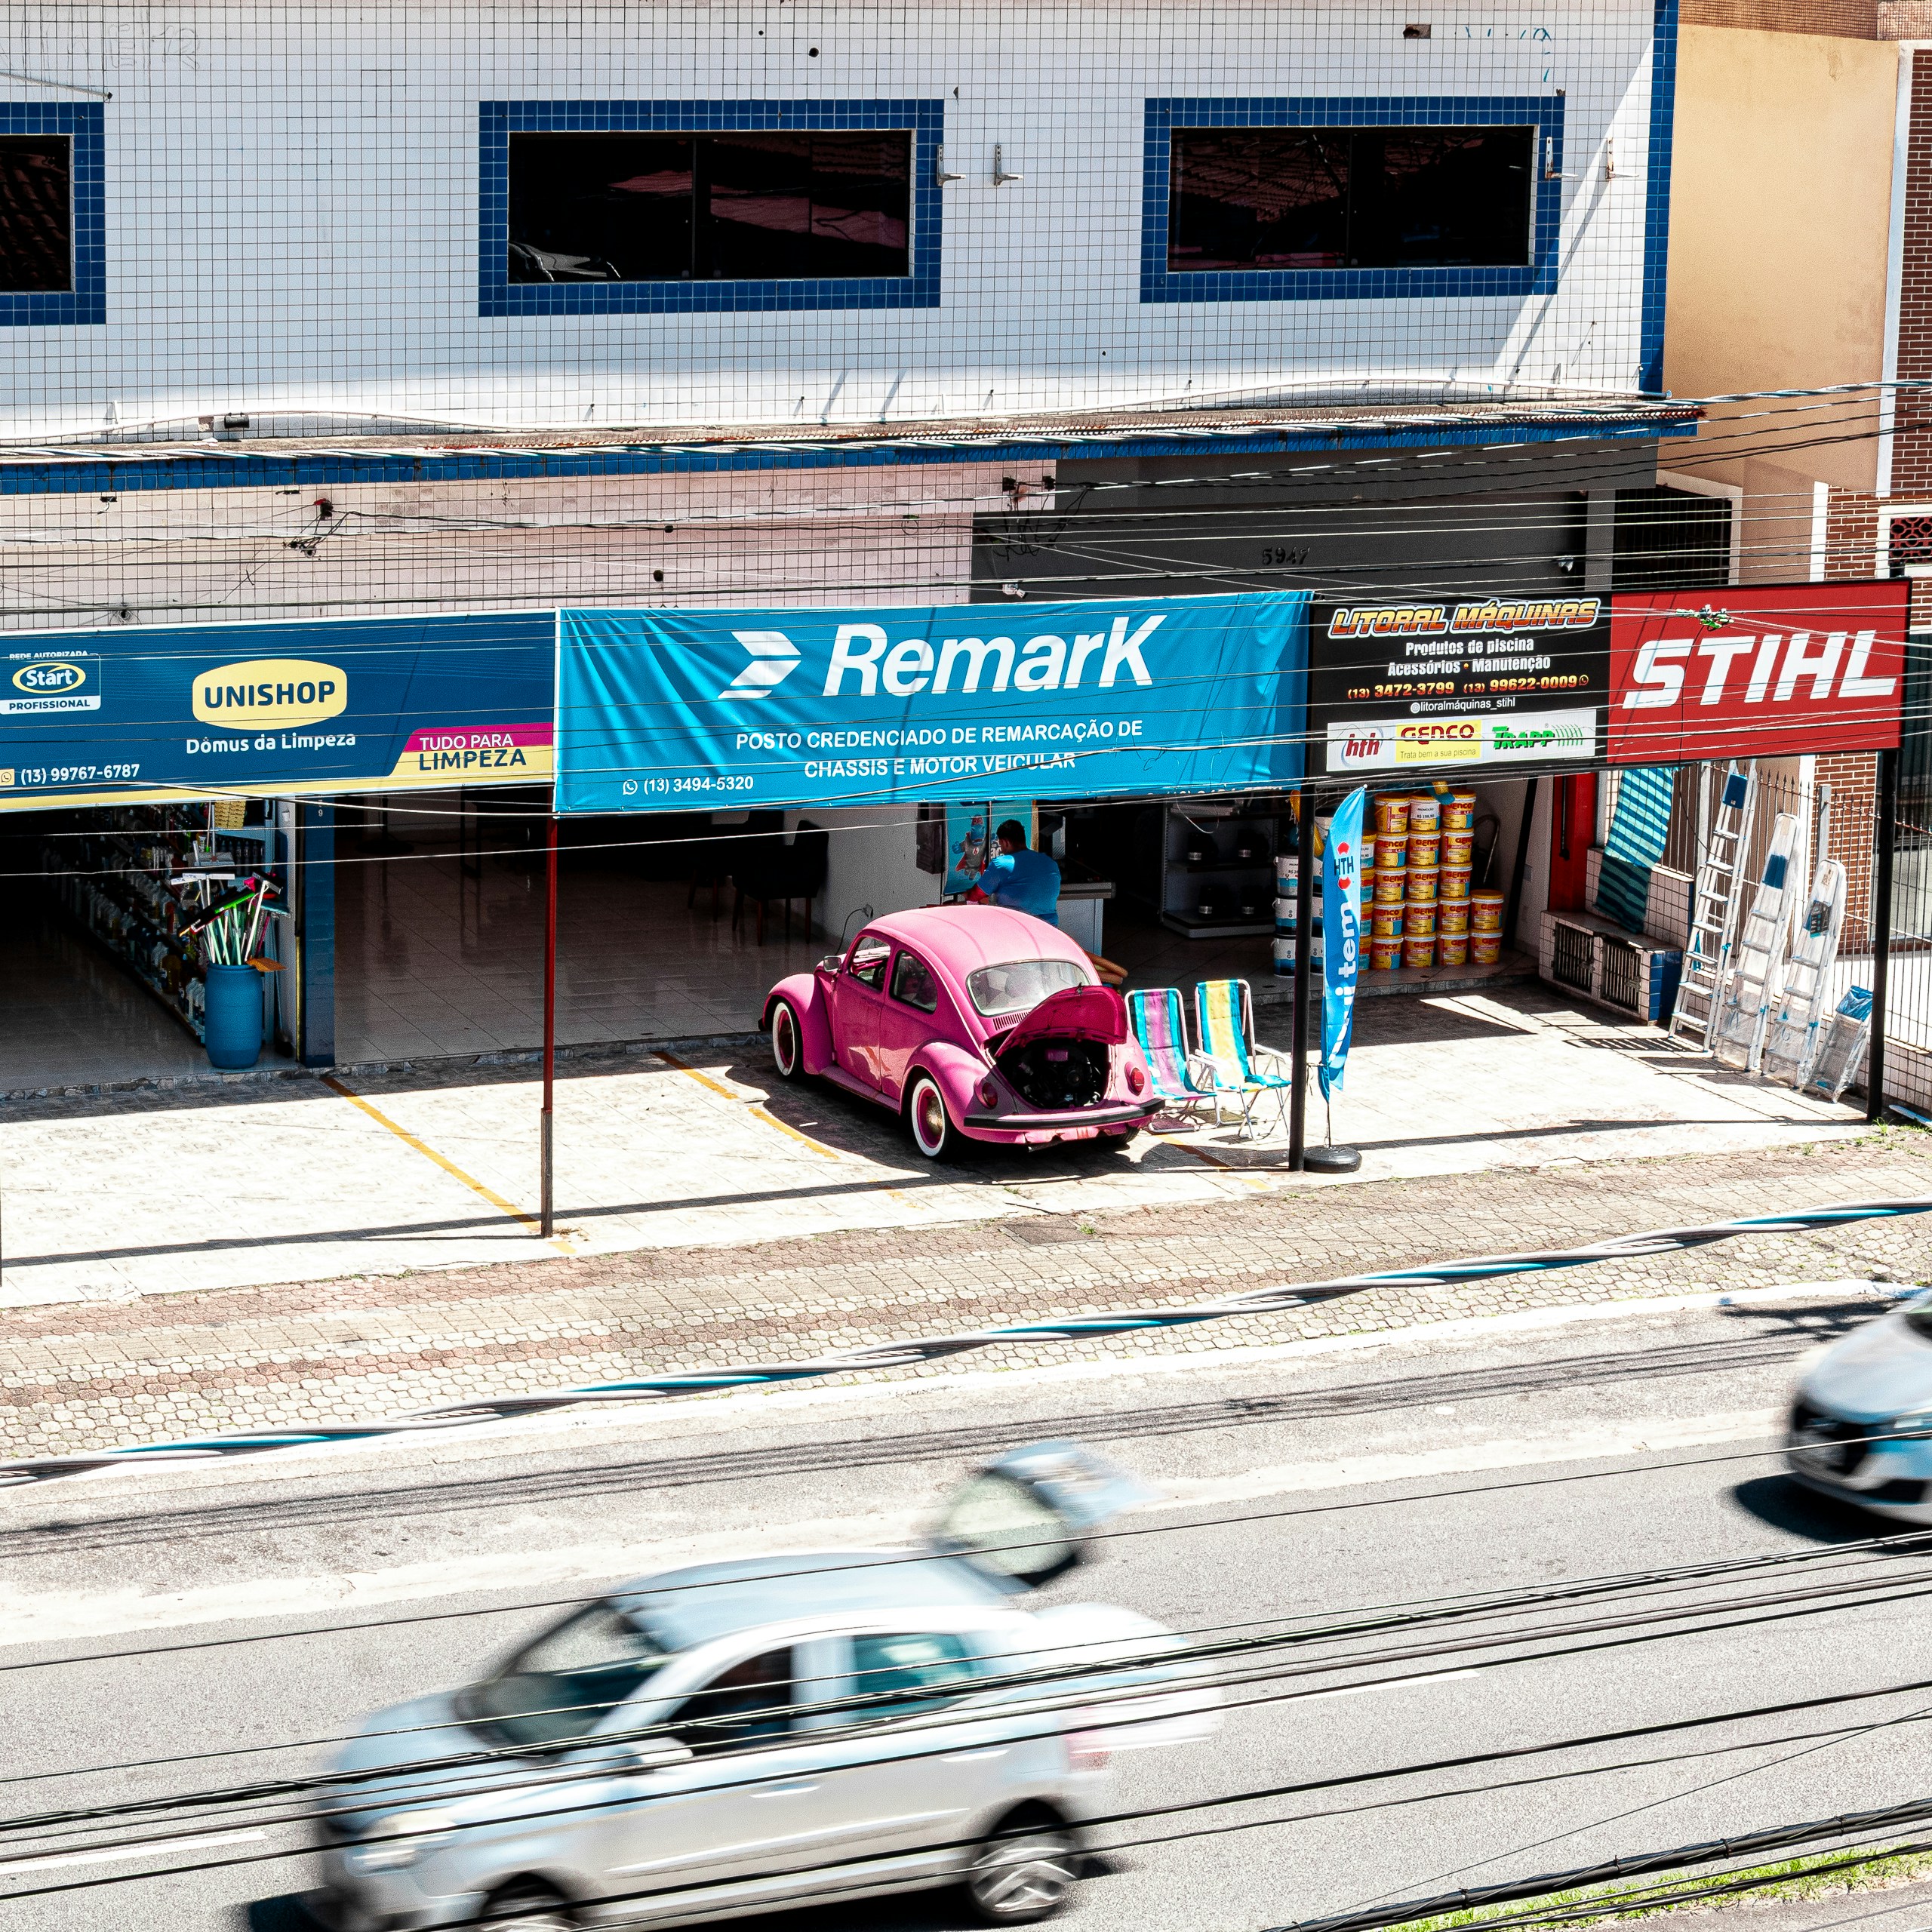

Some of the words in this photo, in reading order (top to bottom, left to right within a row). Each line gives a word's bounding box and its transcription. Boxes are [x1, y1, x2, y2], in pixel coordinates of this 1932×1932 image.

[1262, 546, 1310, 565] 5947
[1330, 608, 1447, 637] LITORAL
[1451, 599, 1599, 632] MÁQUINAS
[9, 652, 31, 660] REDE
[33, 650, 88, 658] AUTORIZADA
[1405, 641, 1464, 657] Produtos
[1467, 639, 1484, 654] de
[1487, 638, 1534, 654] piscina
[1387, 660, 1461, 676] Acessórios
[1472, 655, 1551, 672] Manutenção
[1622, 629, 1897, 709] STIHL
[26, 669, 72, 686] Start
[1463, 683, 1485, 694] (13)
[1490, 675, 1577, 692] 99622-0009
[205, 681, 336, 708] UNISHOP
[1347, 688, 1370, 699] (13)
[1374, 681, 1455, 697] 3472-3799
[9, 699, 90, 711] PROFISSIONAL
[186, 736, 249, 754] Dômus
[254, 734, 276, 751] da
[281, 732, 355, 751] Limpeza
[419, 735, 466, 751] TUDO
[470, 734, 514, 749] PARA
[736, 732, 801, 749] POSTO
[807, 728, 946, 749] CREDENCIADO
[952, 728, 977, 744] DE
[982, 718, 1114, 743] REMARCAÇÃO
[1118, 720, 1143, 737] DE
[1401, 724, 1475, 745] GENCO
[419, 748, 527, 771] LIMPEZA
[1400, 750, 1417, 759] Trata
[1418, 749, 1433, 758] bem
[1454, 749, 1476, 758] piscina
[20, 768, 47, 785] (13)
[51, 764, 140, 782] 99767-6787
[804, 759, 888, 778] CHASSIS
[894, 758, 905, 774] E
[909, 755, 977, 774] MOTOR
[982, 752, 1075, 772] VEICULAR
[644, 777, 669, 795] (13)
[673, 776, 754, 792] 3494-5320
[1334, 856, 1354, 875] HTH
[1338, 901, 1356, 978] tem
